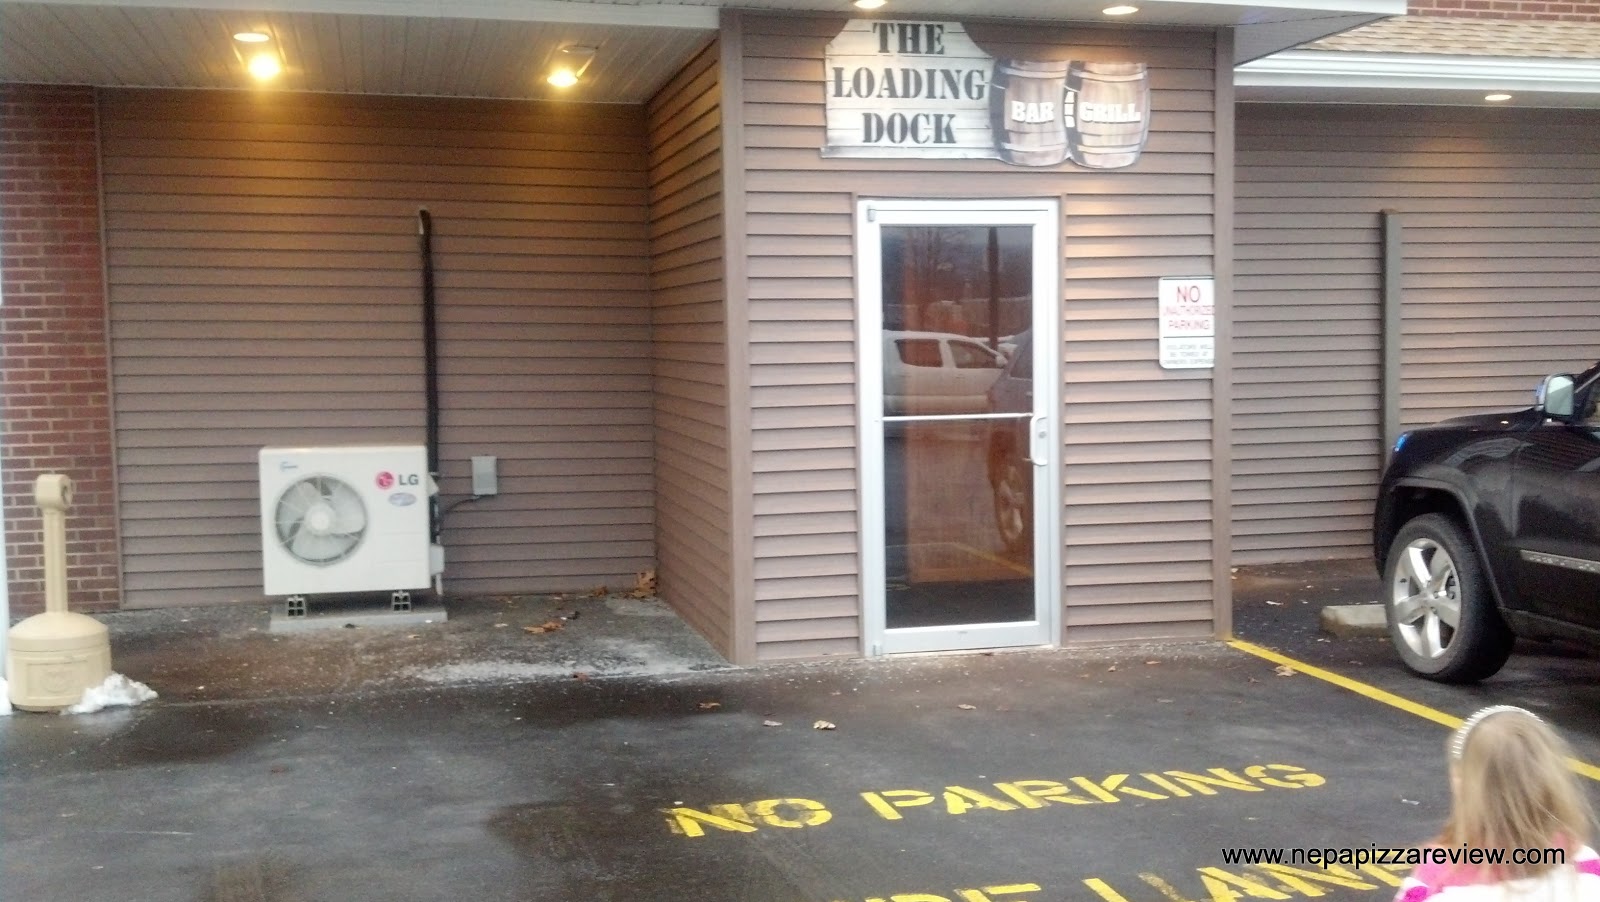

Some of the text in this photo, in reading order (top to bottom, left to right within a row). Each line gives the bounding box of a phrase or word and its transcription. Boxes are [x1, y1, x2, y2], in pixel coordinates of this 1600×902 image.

[873, 22, 945, 55] THE
[832, 66, 986, 101] LOADING
[1011, 100, 1055, 124] BAR
[1079, 101, 1141, 124] GRILL
[862, 112, 957, 144] DOCK
[1177, 285, 1200, 303] NO
[1168, 319, 1210, 330] PARKING
[399, 474, 419, 486] LG
[659, 764, 1326, 837] NO PARKING
